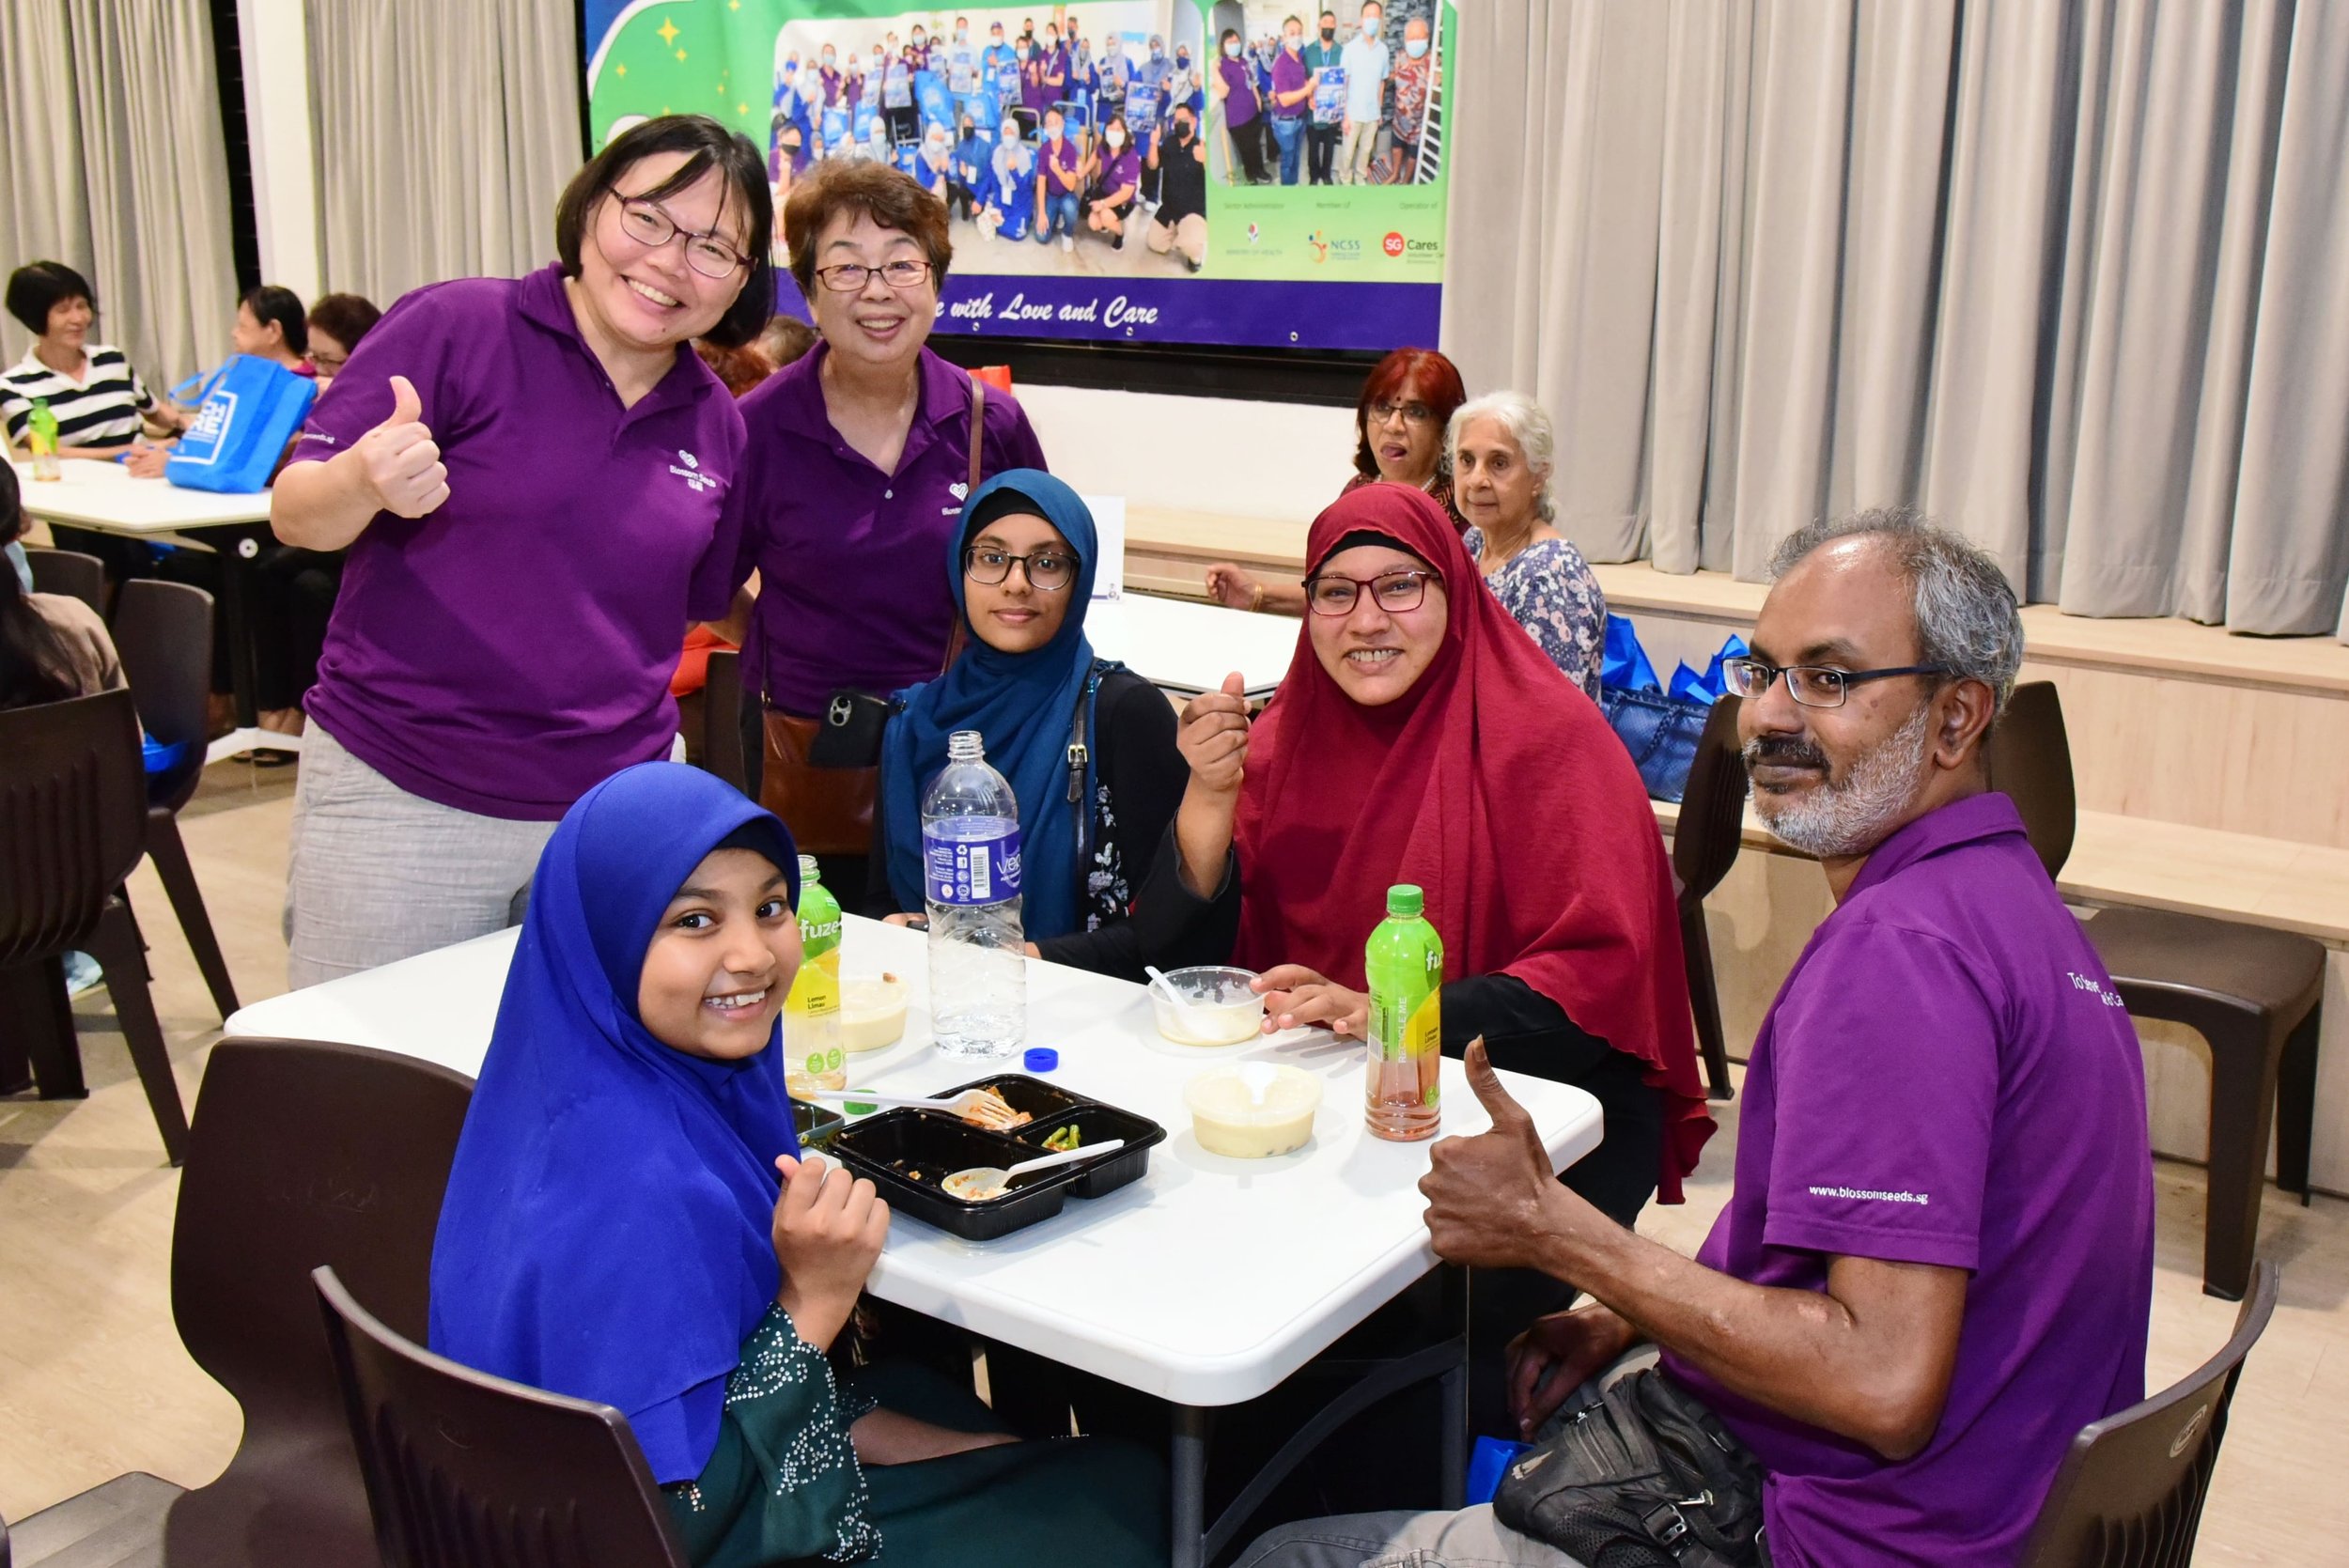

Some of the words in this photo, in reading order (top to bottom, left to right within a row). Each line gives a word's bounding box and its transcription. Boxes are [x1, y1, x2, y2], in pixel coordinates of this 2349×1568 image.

[1330, 240, 1361, 250] NCSS
[1385, 238, 1402, 251] SG
[1407, 239, 1438, 251] Cares
[950, 292, 993, 318] with
[998, 293, 1052, 321] Love
[1058, 298, 1097, 322] and
[1103, 295, 1158, 328] Care
[807, 995, 827, 1003] Lemon
[1398, 997, 1407, 1014] ME
[1398, 1015, 1407, 1063] RECYCLE
[1809, 1186, 1928, 1205] www.blossomseeds.sg
